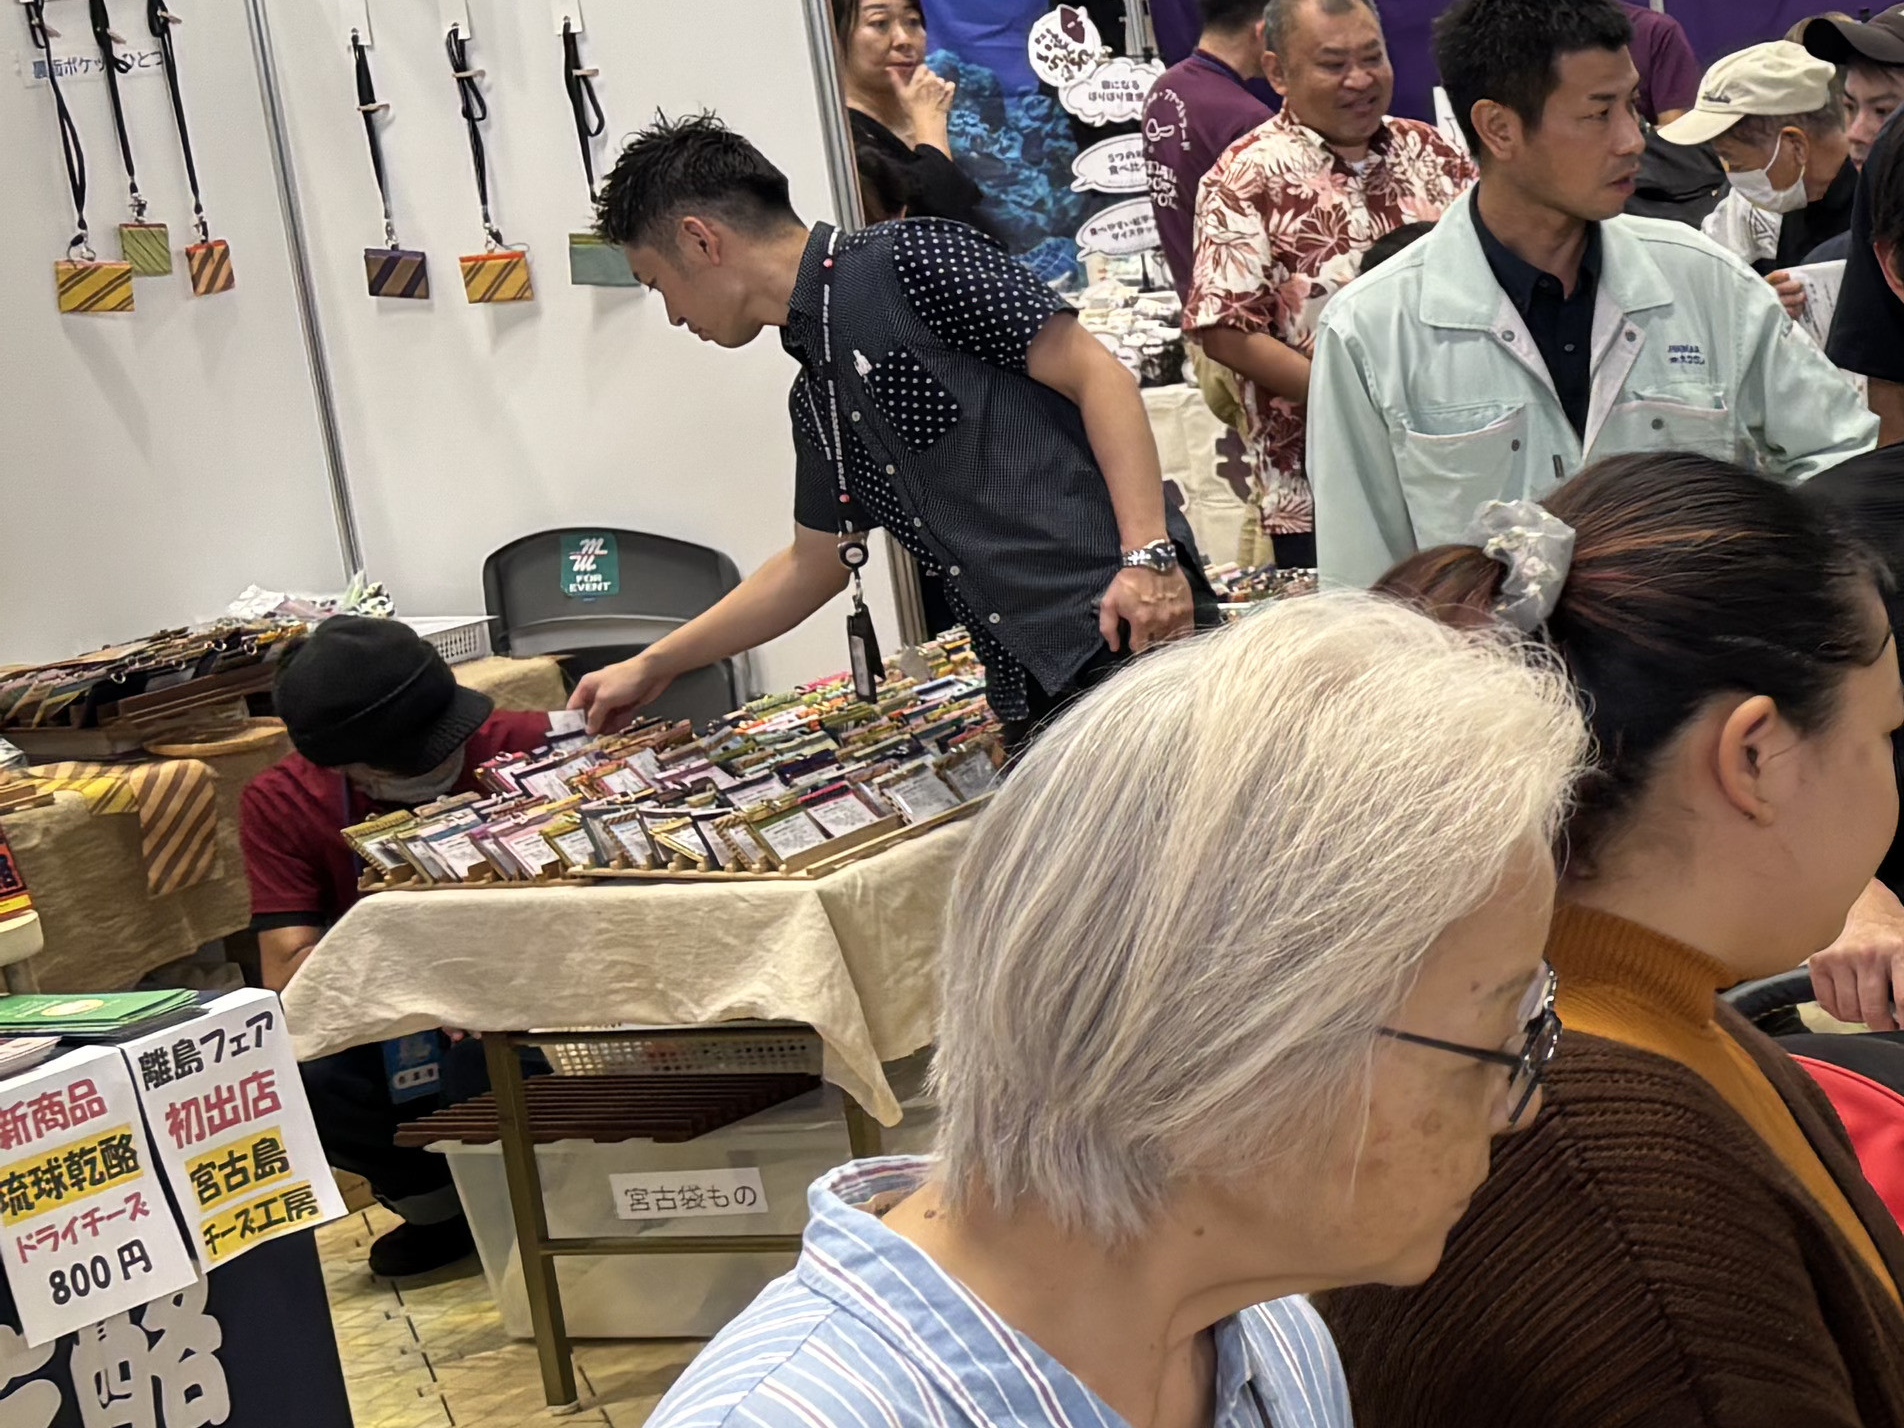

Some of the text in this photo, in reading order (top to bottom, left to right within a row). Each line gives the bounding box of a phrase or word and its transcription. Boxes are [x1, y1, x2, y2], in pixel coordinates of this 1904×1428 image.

[569, 581, 612, 593] EVENT
[575, 573, 603, 583] FOR
[138, 1008, 275, 1092] 離島フェア
[0, 1078, 109, 1151] 新商品
[165, 1069, 282, 1150] 初出店
[0, 1133, 141, 1217] 琉球乾酪
[190, 1136, 290, 1206] 宮古島
[623, 1182, 758, 1215] 宮古袋もの
[15, 1190, 151, 1265] ドライチーズ
[203, 1183, 318, 1255] チーズ工房
[49, 1237, 153, 1306] 800円
